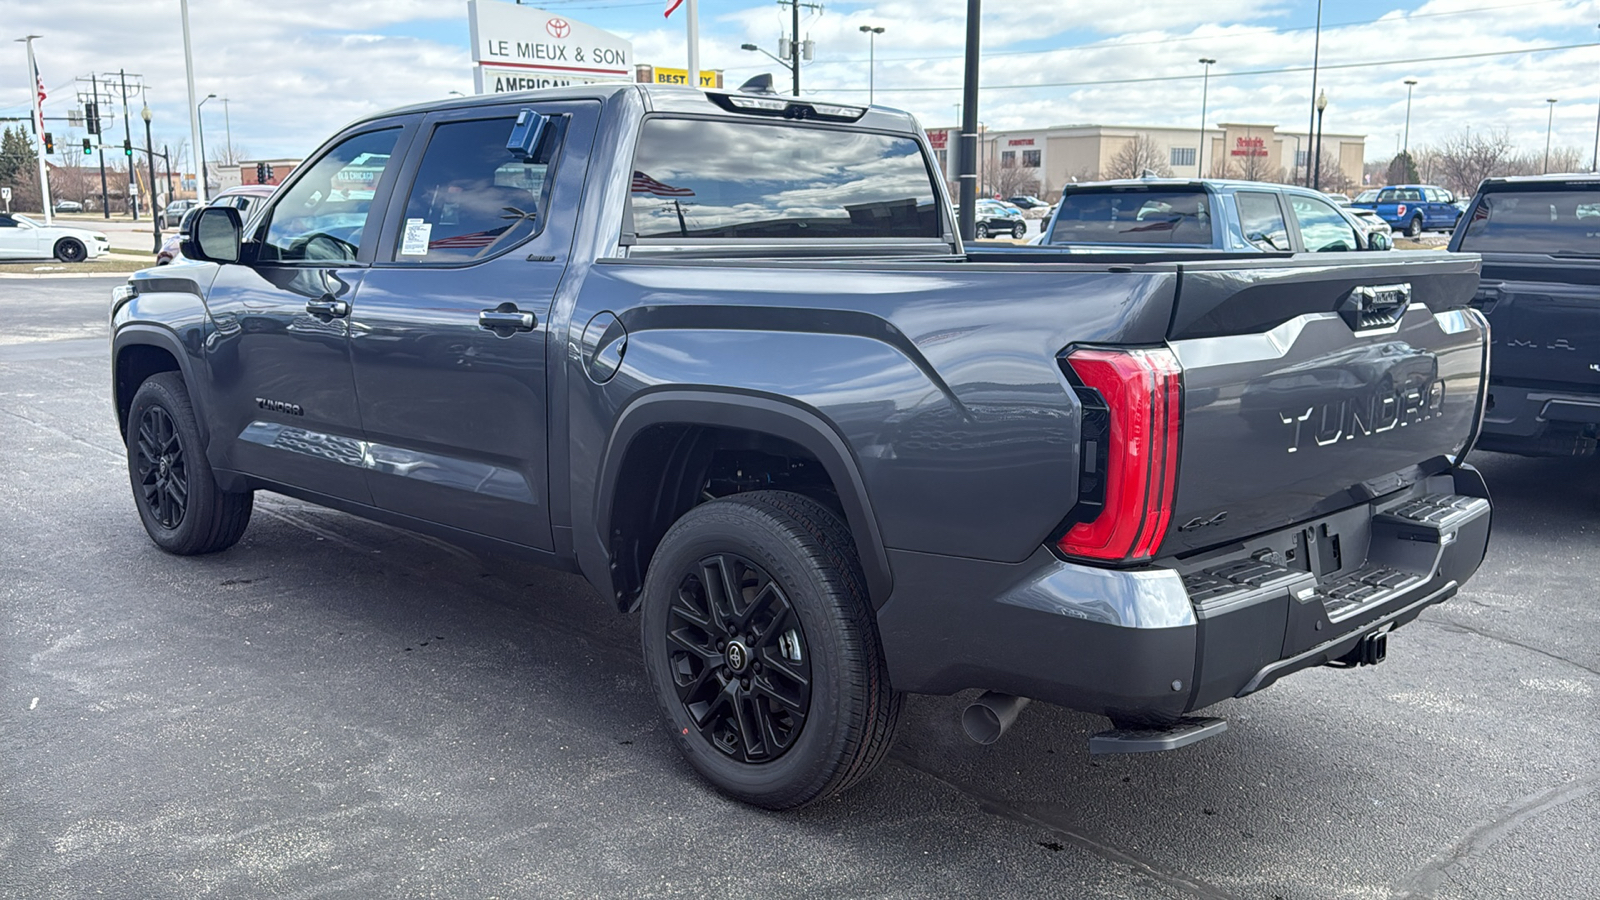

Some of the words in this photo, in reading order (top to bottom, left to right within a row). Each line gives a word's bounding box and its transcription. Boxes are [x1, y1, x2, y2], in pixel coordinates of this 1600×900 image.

[488, 40, 509, 57] LE
[517, 42, 567, 61] MIEUX
[574, 47, 586, 62] &
[593, 49, 626, 65] SON
[658, 73, 686, 84] BEST
[255, 397, 304, 416] TUNDRA
[1279, 378, 1446, 453] TUNDRA
